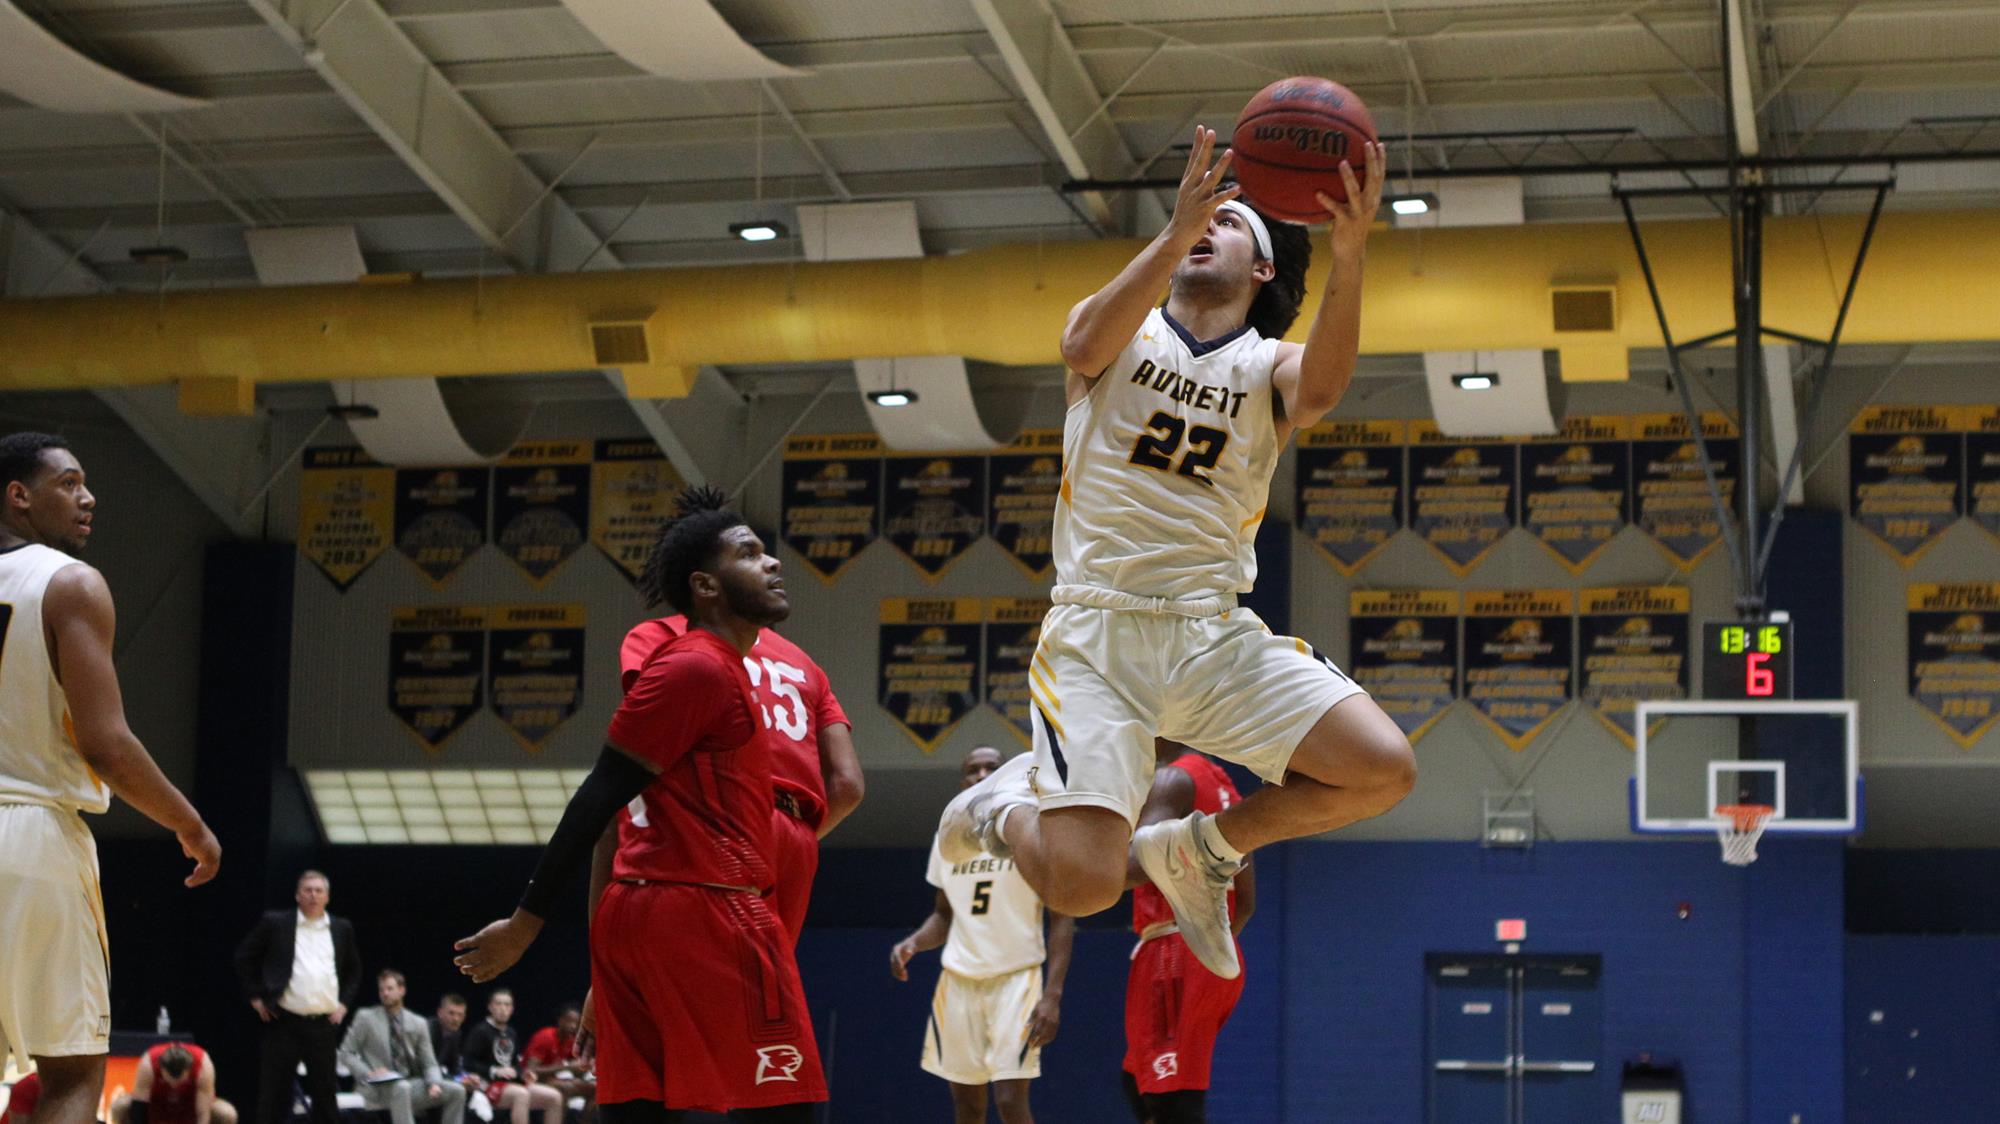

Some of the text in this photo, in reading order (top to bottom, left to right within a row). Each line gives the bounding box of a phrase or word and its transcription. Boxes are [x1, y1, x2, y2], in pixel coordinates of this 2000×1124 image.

[1254, 125, 1349, 157] Wilson
[1128, 409, 1229, 487] 22
[507, 609, 567, 621] FOOTBALL
[1360, 602, 1448, 613] BASKETBALL
[1474, 602, 1562, 613] BASKETBALL
[1590, 599, 1676, 612] BASKETBALL
[1720, 626, 1782, 654] 13:16
[1746, 652, 1775, 696] 6
[970, 879, 994, 916] 5
